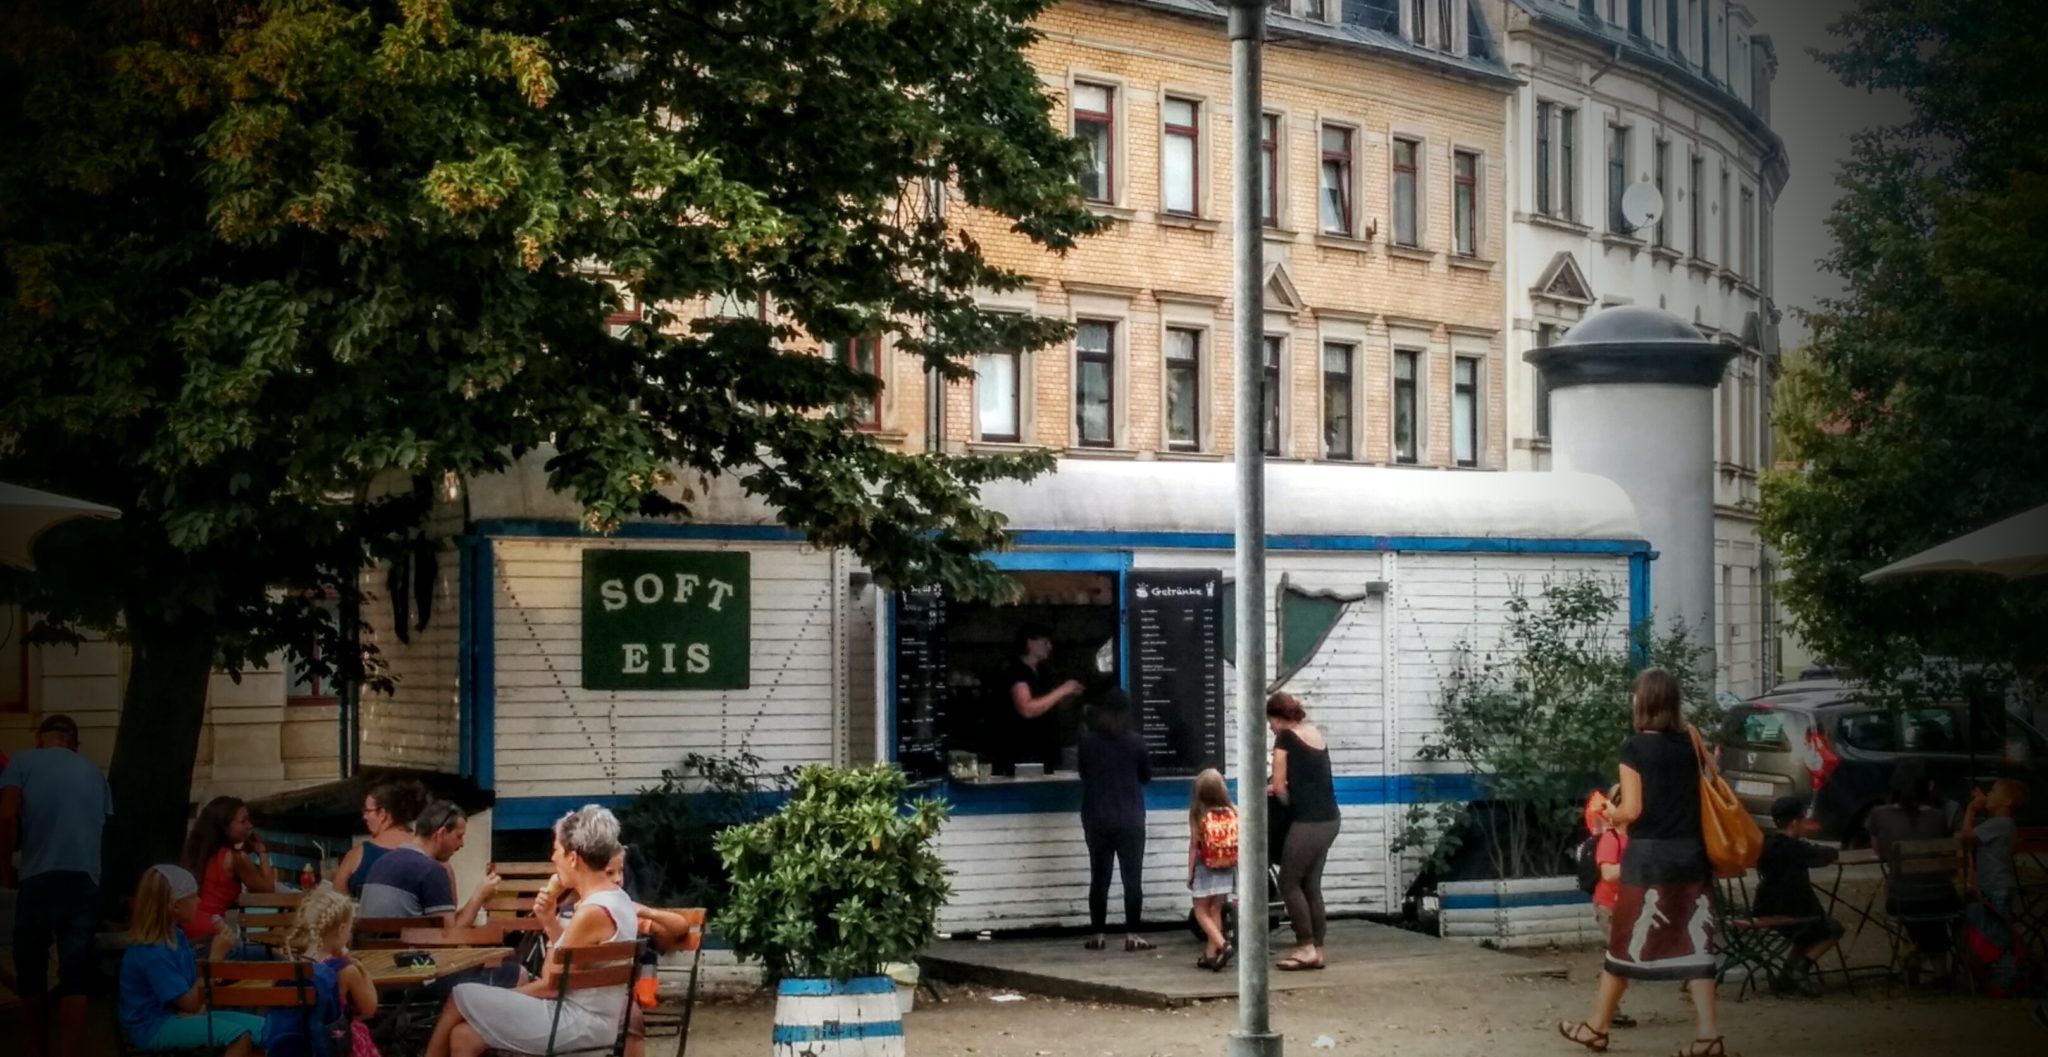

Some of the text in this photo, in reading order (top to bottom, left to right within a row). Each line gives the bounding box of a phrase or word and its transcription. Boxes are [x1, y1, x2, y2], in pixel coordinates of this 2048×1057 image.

[600, 572, 734, 612] SOFT
[1151, 586, 1203, 597] Getränke
[621, 643, 711, 674] EIS
